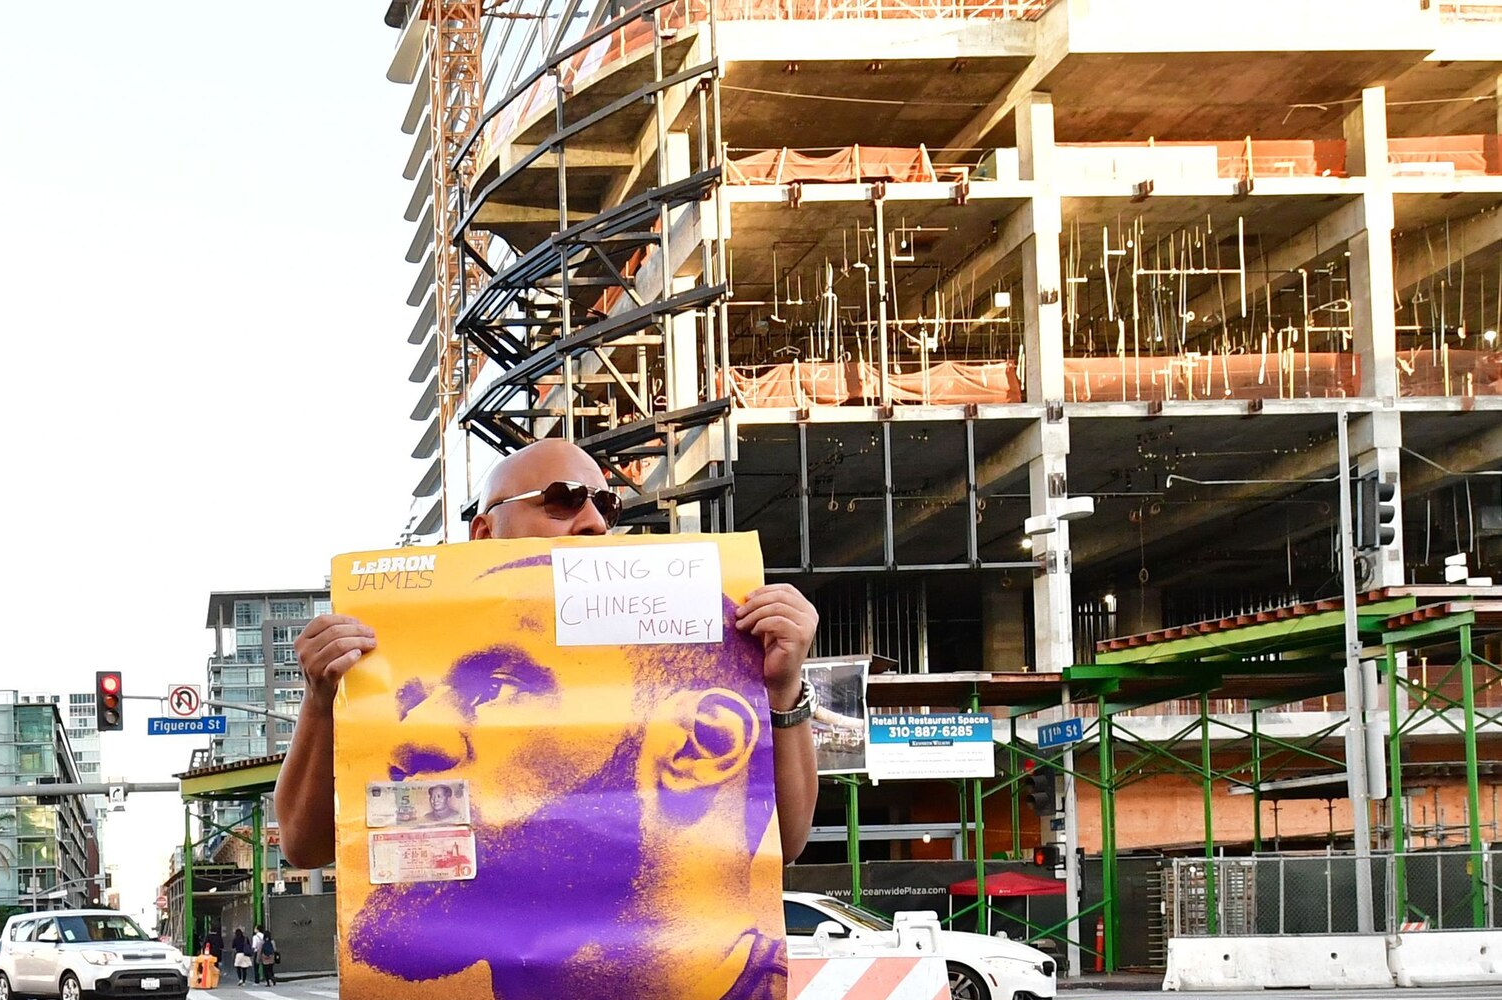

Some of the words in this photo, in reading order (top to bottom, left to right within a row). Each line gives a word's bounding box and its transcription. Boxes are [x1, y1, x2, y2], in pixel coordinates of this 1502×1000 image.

[348, 570, 433, 591] JAMES
[562, 557, 650, 583] KING
[667, 558, 705, 579] OF
[560, 594, 667, 626] CHINESE
[638, 618, 714, 640] MONEY
[153, 720, 204, 733] Figueroa
[207, 719, 221, 730] St
[871, 716, 898, 726] Retail
[899, 716, 906, 725] &
[907, 716, 956, 725] Restaurant
[958, 715, 990, 725] Spaces
[888, 725, 974, 738] 310-887-6285
[1042, 726, 1062, 744] 11th
[1065, 723, 1078, 738] St
